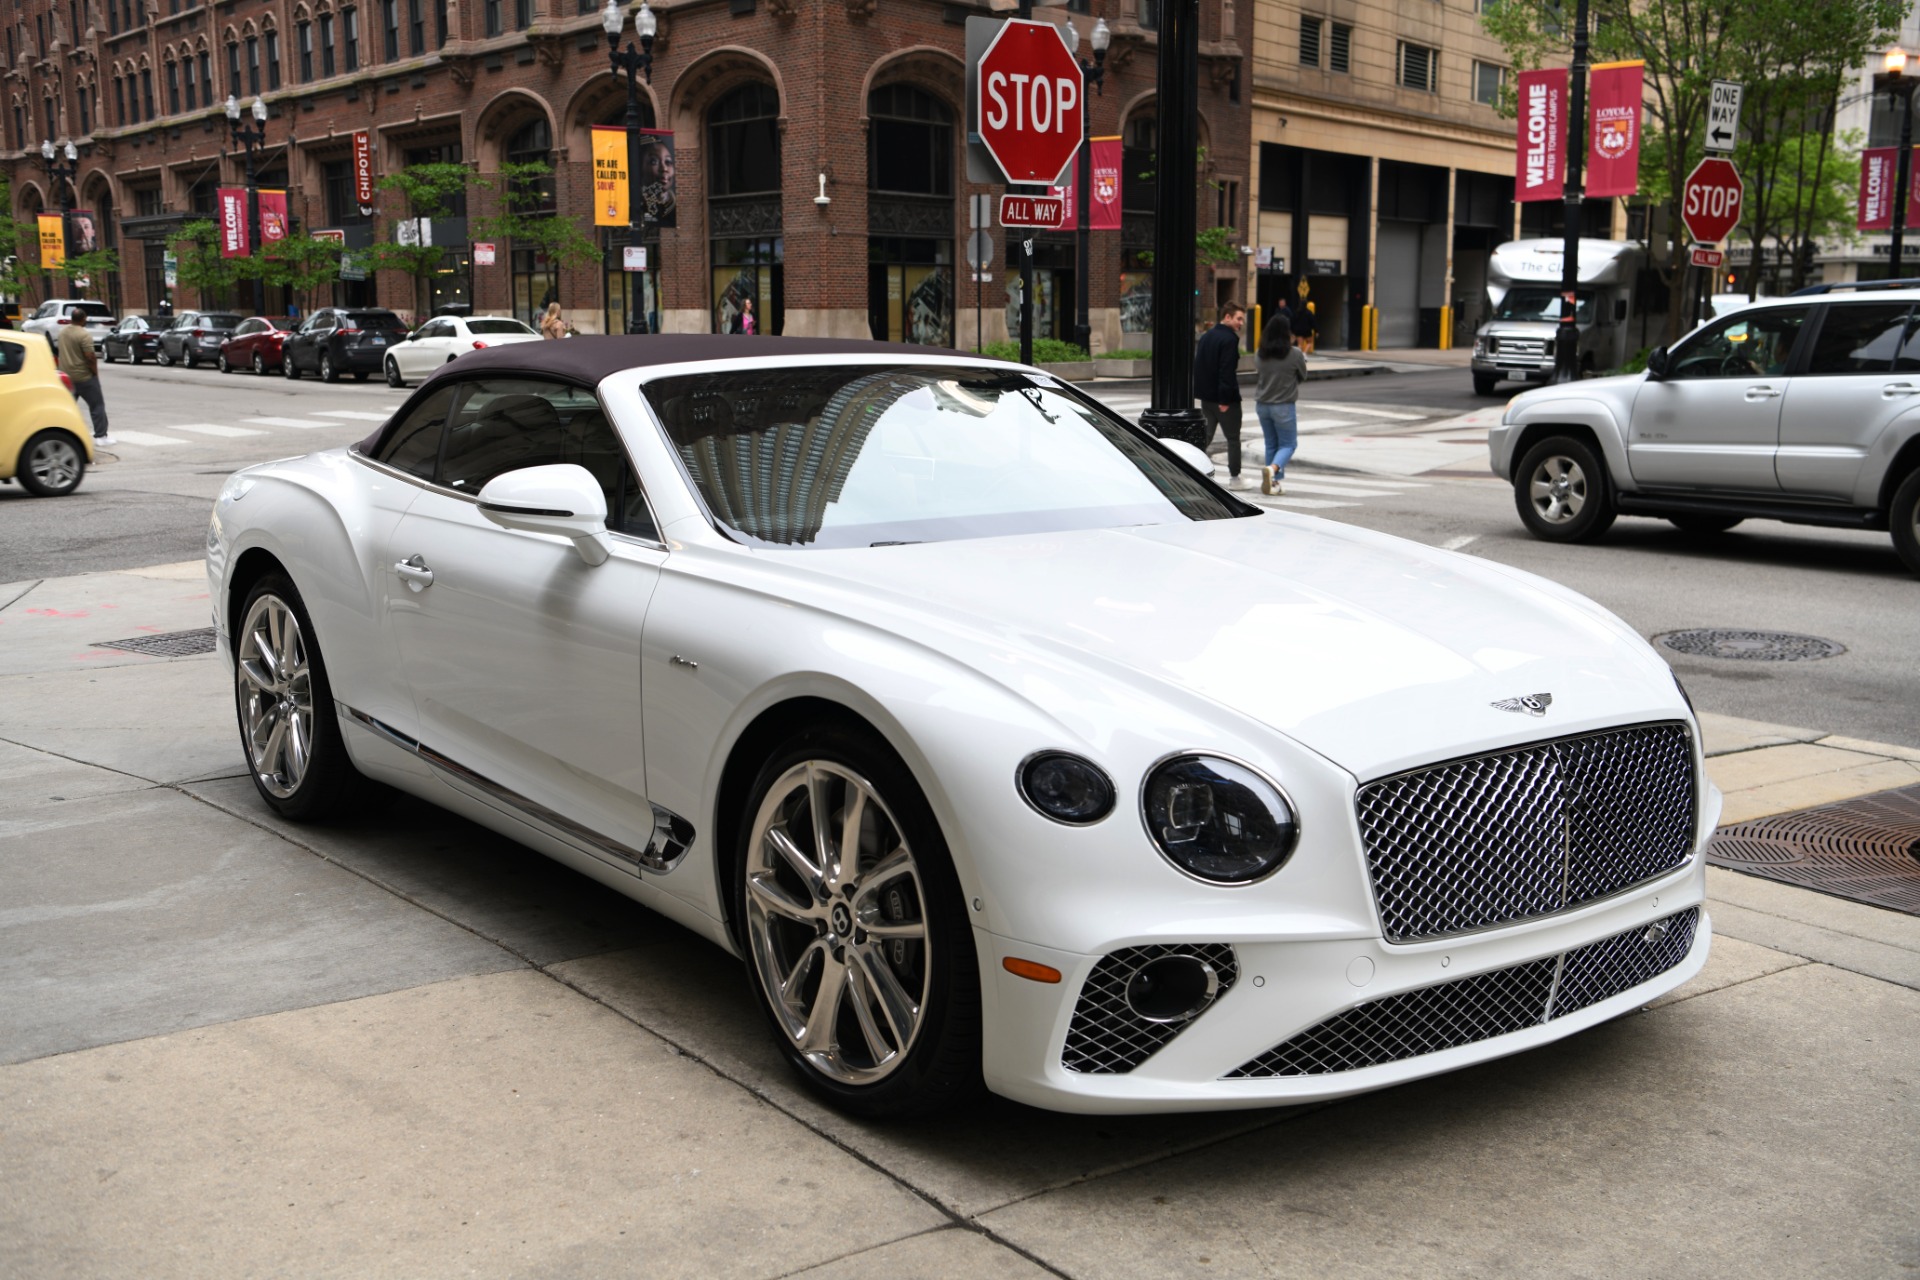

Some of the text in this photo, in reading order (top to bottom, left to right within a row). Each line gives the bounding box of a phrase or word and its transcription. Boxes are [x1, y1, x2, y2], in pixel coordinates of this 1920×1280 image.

[987, 71, 1077, 134] STOP
[1714, 87, 1738, 105] ONE
[1596, 106, 1634, 118] LOYOLA
[1712, 106, 1736, 124] WAY
[1526, 84, 1547, 188] WELCOME
[1547, 89, 1558, 181] WATER TOWER CAMPUS
[357, 135, 370, 200] CHIPOTLE
[596, 159, 618, 169] WE ARE
[596, 170, 627, 180] CALLED TO
[597, 181, 615, 191] SOLVE
[1865, 156, 1882, 222] WELCOME
[1687, 184, 1739, 218] STOP
[1007, 202, 1058, 221] ALL WAY
[224, 196, 238, 251] WELCOME
[1694, 251, 1706, 263] ALL
[1521, 262, 1543, 272] The
